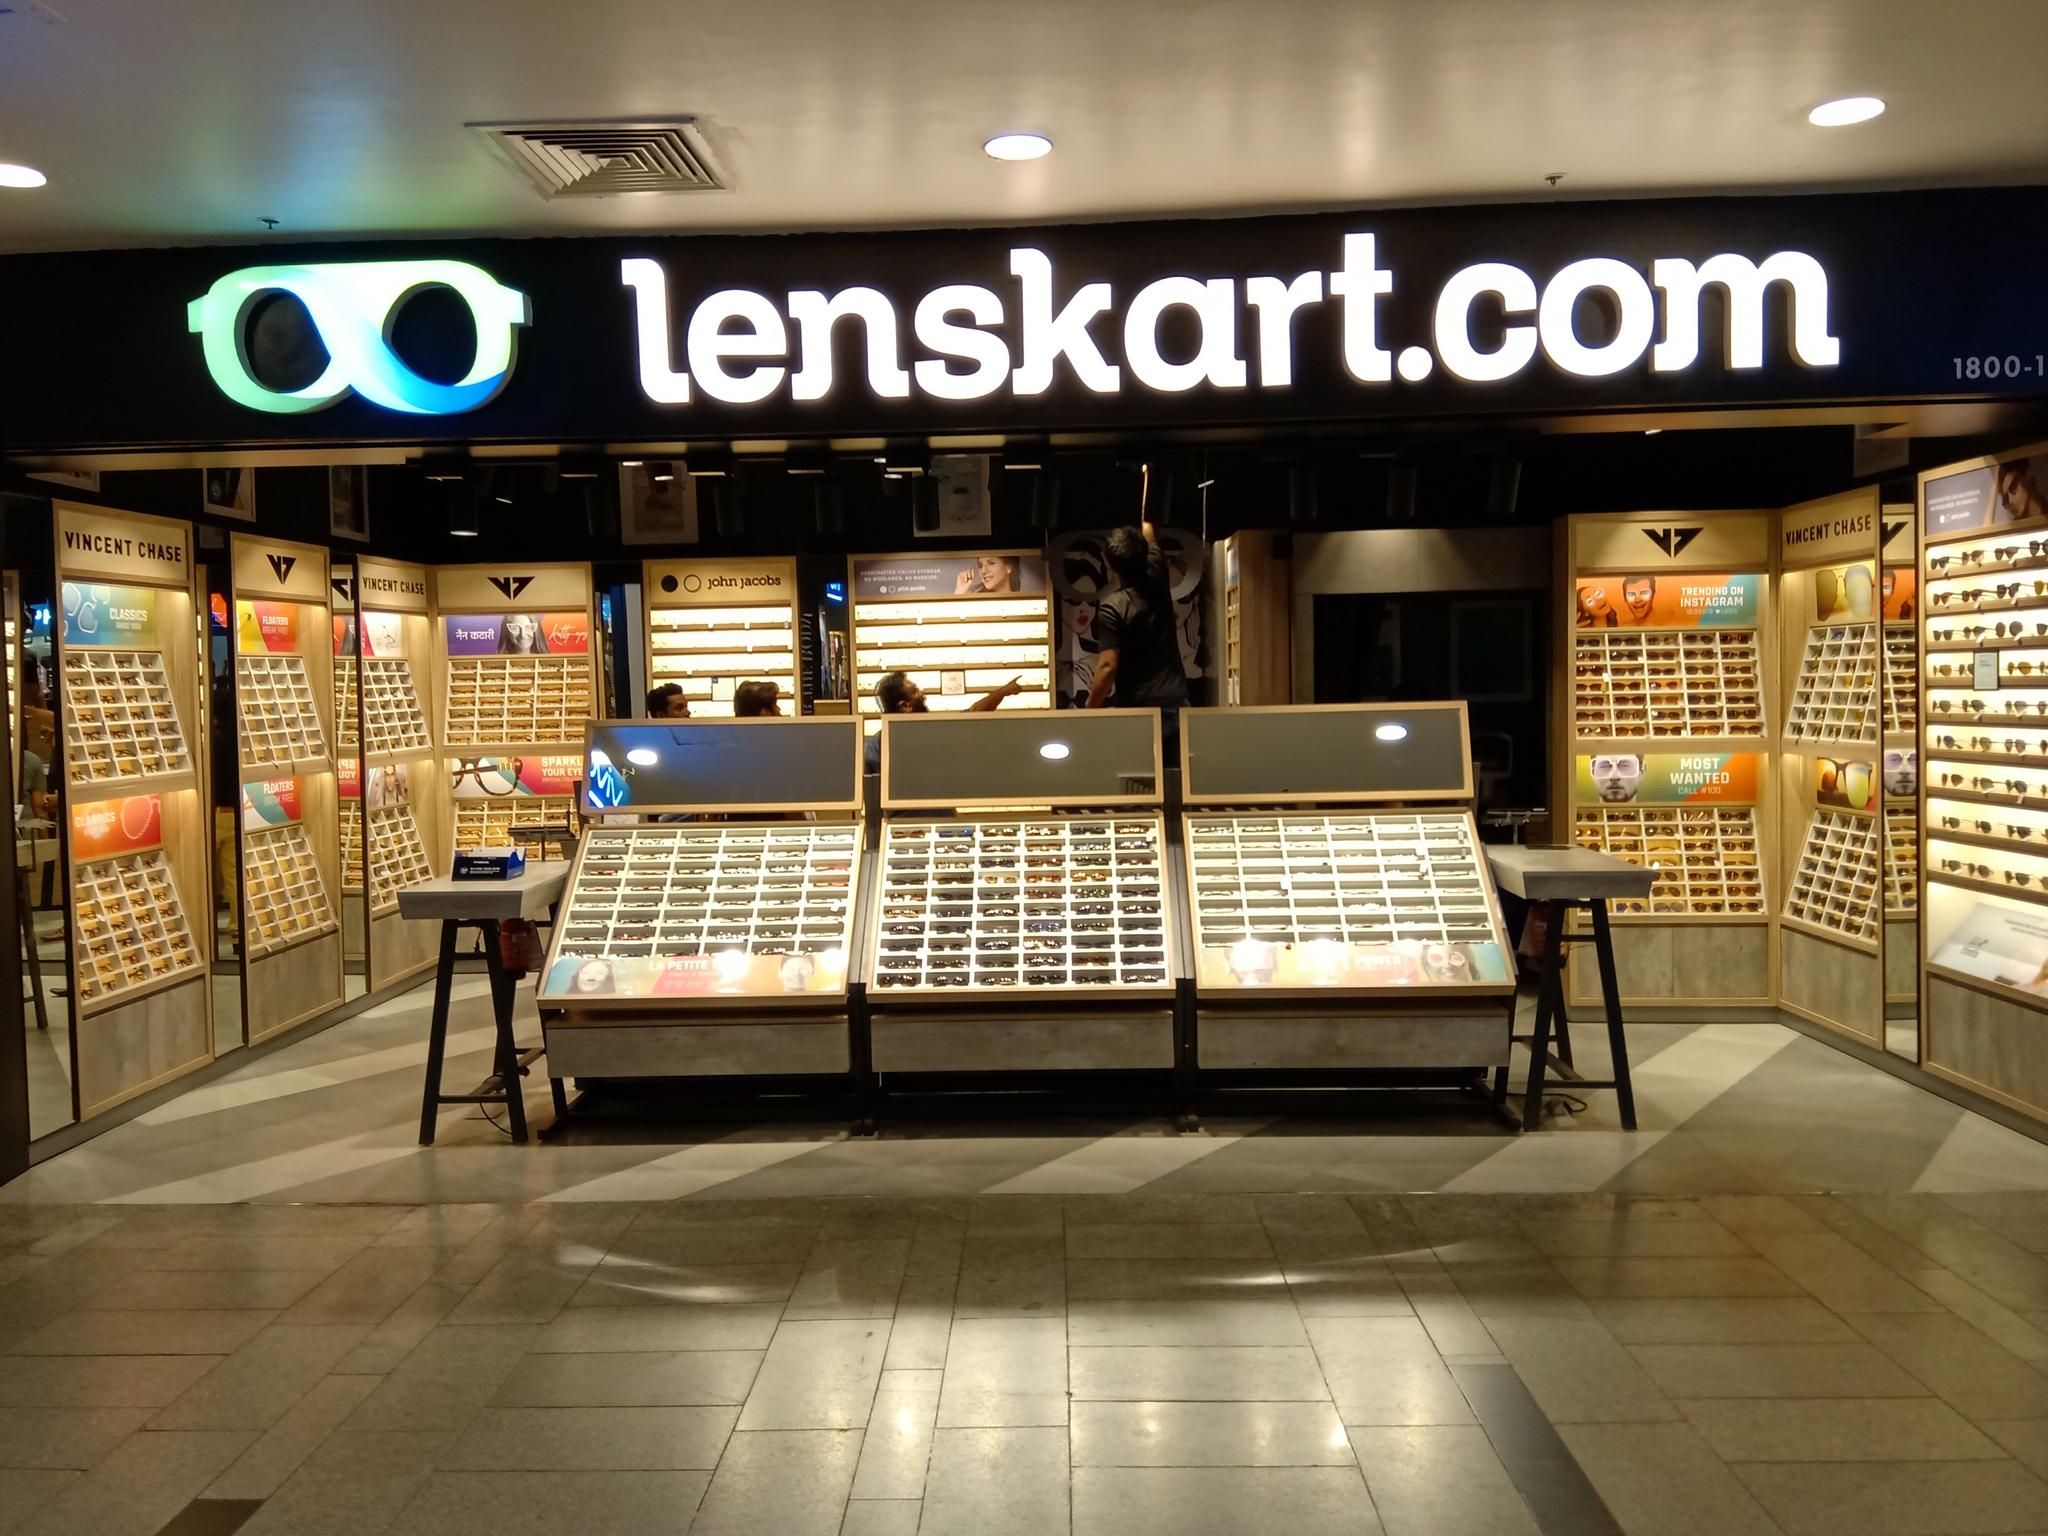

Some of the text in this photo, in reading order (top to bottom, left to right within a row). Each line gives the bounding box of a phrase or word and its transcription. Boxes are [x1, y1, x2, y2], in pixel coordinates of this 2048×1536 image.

[622, 233, 1839, 403] lenskart.com
[1953, 355, 2044, 379] 1800-1
[1786, 514, 1872, 545] VINCENT CHASE
[65, 531, 182, 562] VINCENT CHASE
[363, 577, 424, 594] VINCENT CHASE
[707, 575, 782, 590] john jacobs
[1681, 586, 1744, 596] TRENDING ON
[1680, 596, 1744, 608] INSTAGRAM
[109, 607, 148, 621] CLASSICS
[1680, 757, 1720, 770] MOST
[542, 768, 565, 777] YOUR
[1670, 772, 1730, 785] WANTED
[667, 960, 708, 971] PETITE
